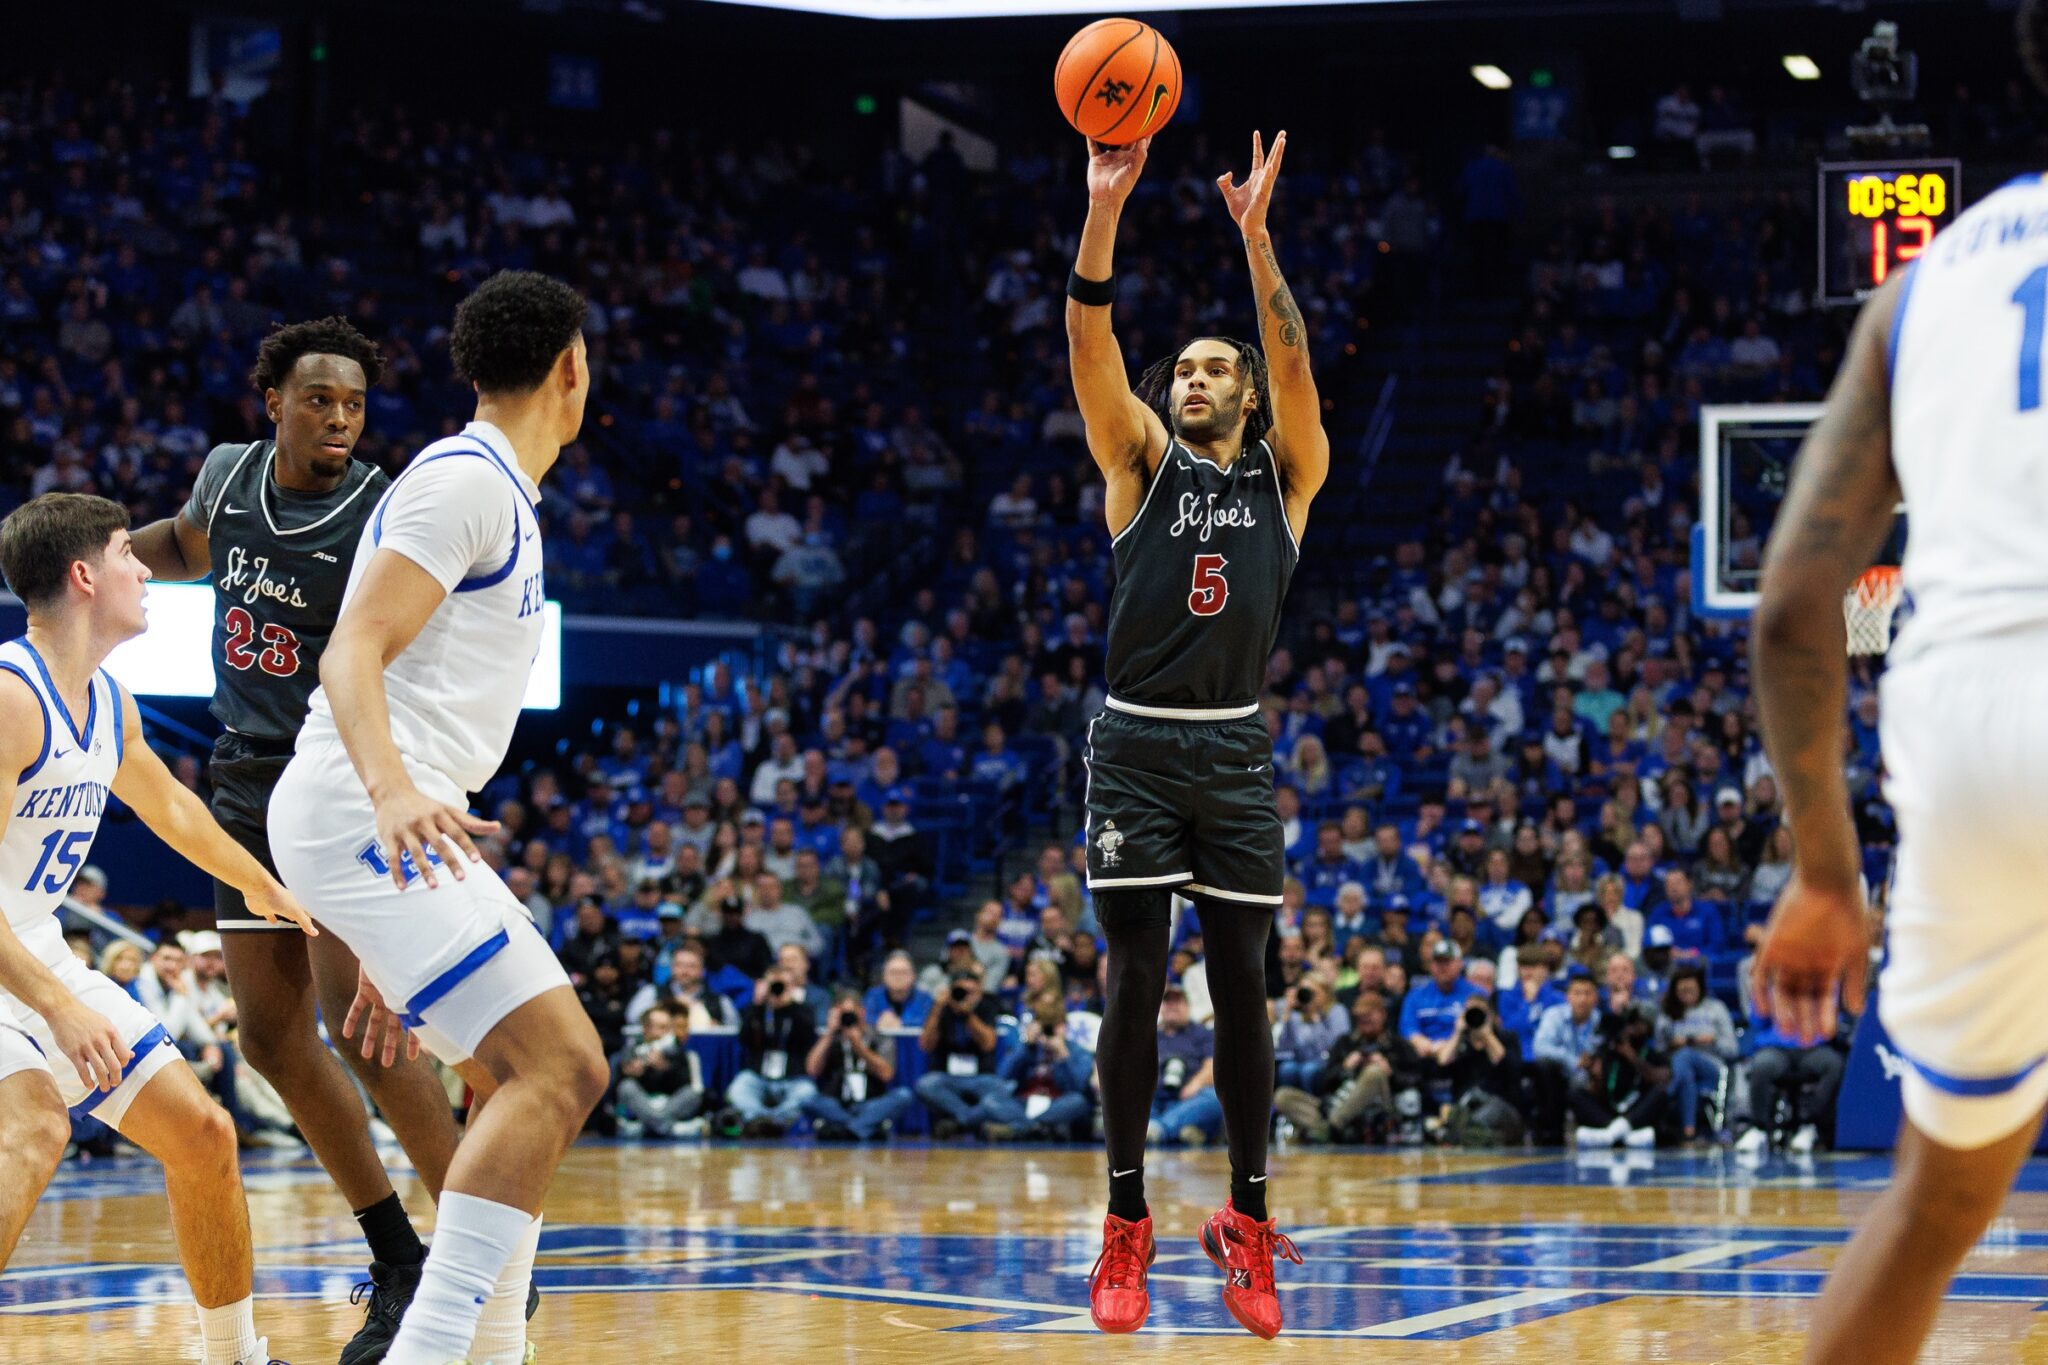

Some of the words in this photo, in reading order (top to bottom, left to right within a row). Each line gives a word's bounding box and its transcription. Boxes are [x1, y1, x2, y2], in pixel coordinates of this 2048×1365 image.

[1848, 173, 1946, 218] 10:50
[2010, 265, 2048, 414] 1
[1188, 553, 1230, 616] 5
[225, 606, 301, 677] 23
[24, 829, 94, 894] 15
